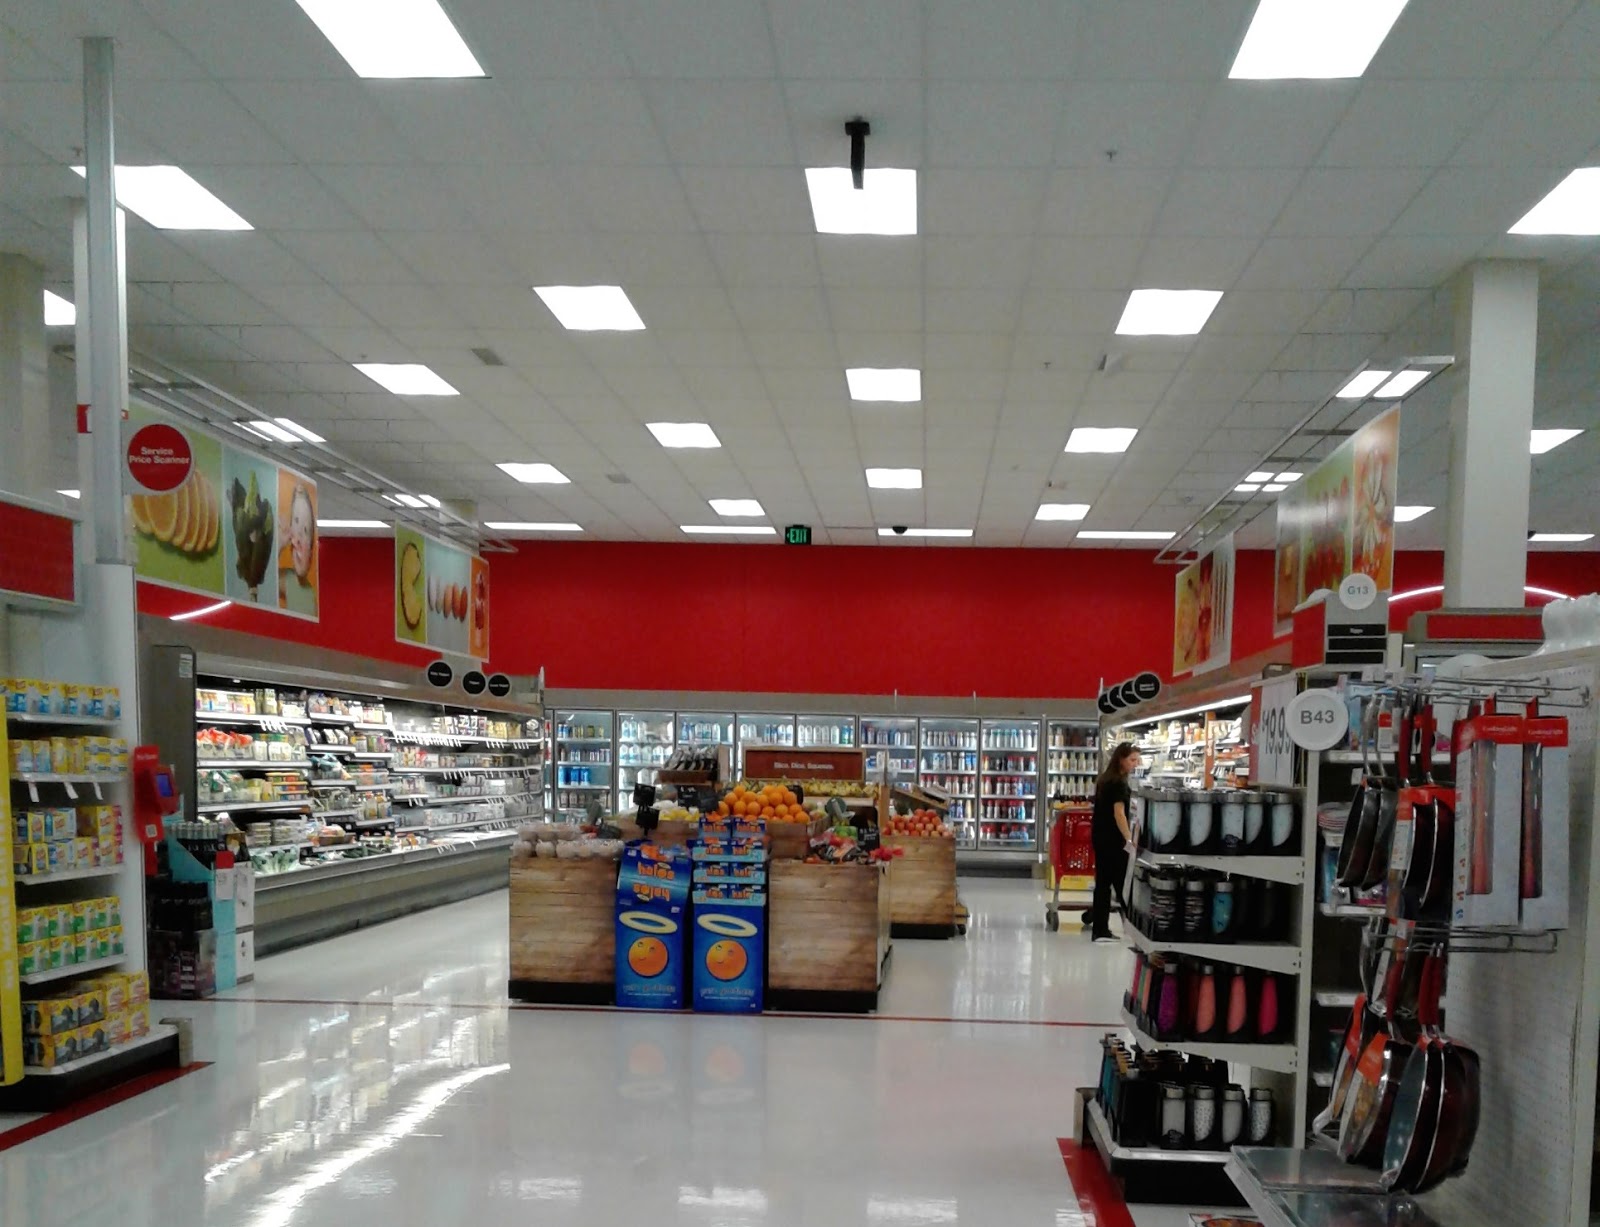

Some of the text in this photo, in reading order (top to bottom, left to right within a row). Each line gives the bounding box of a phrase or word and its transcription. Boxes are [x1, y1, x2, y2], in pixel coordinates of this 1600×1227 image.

[141, 446, 174, 455] Service
[129, 455, 190, 464] Price Scanner
[1347, 585, 1369, 595] G13
[1301, 710, 1334, 724] B43
[637, 861, 675, 880] halos
